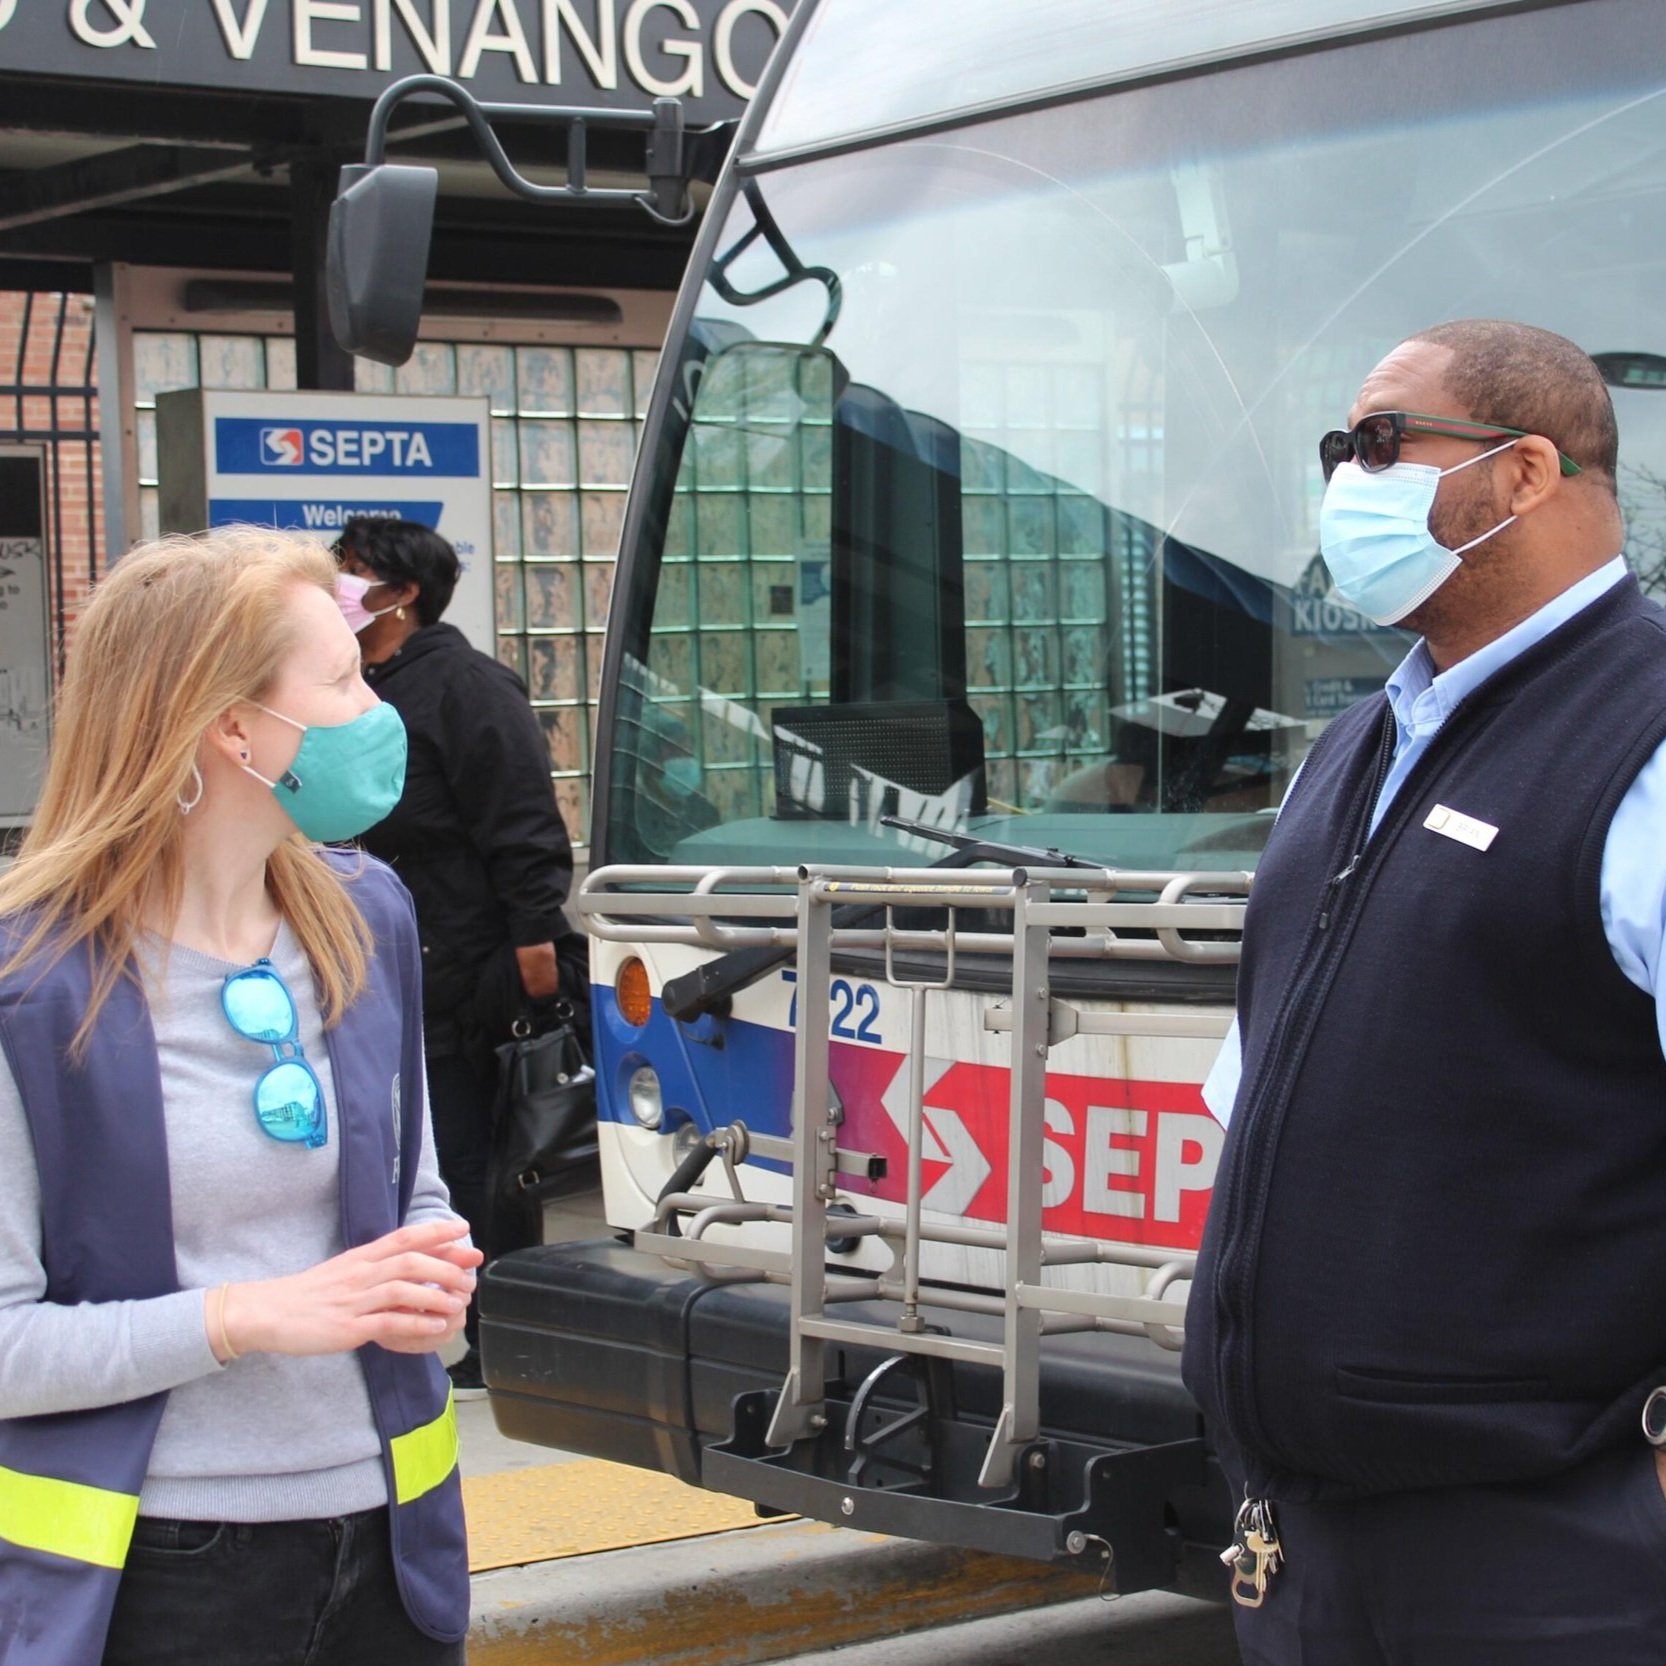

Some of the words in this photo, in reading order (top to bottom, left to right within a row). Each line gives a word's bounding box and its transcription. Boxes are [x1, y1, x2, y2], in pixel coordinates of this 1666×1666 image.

[214, 0, 788, 100] VENANGO
[309, 429, 433, 467] SEPTA
[782, 969, 882, 1045] 722
[1042, 1097, 1226, 1223] SEP
